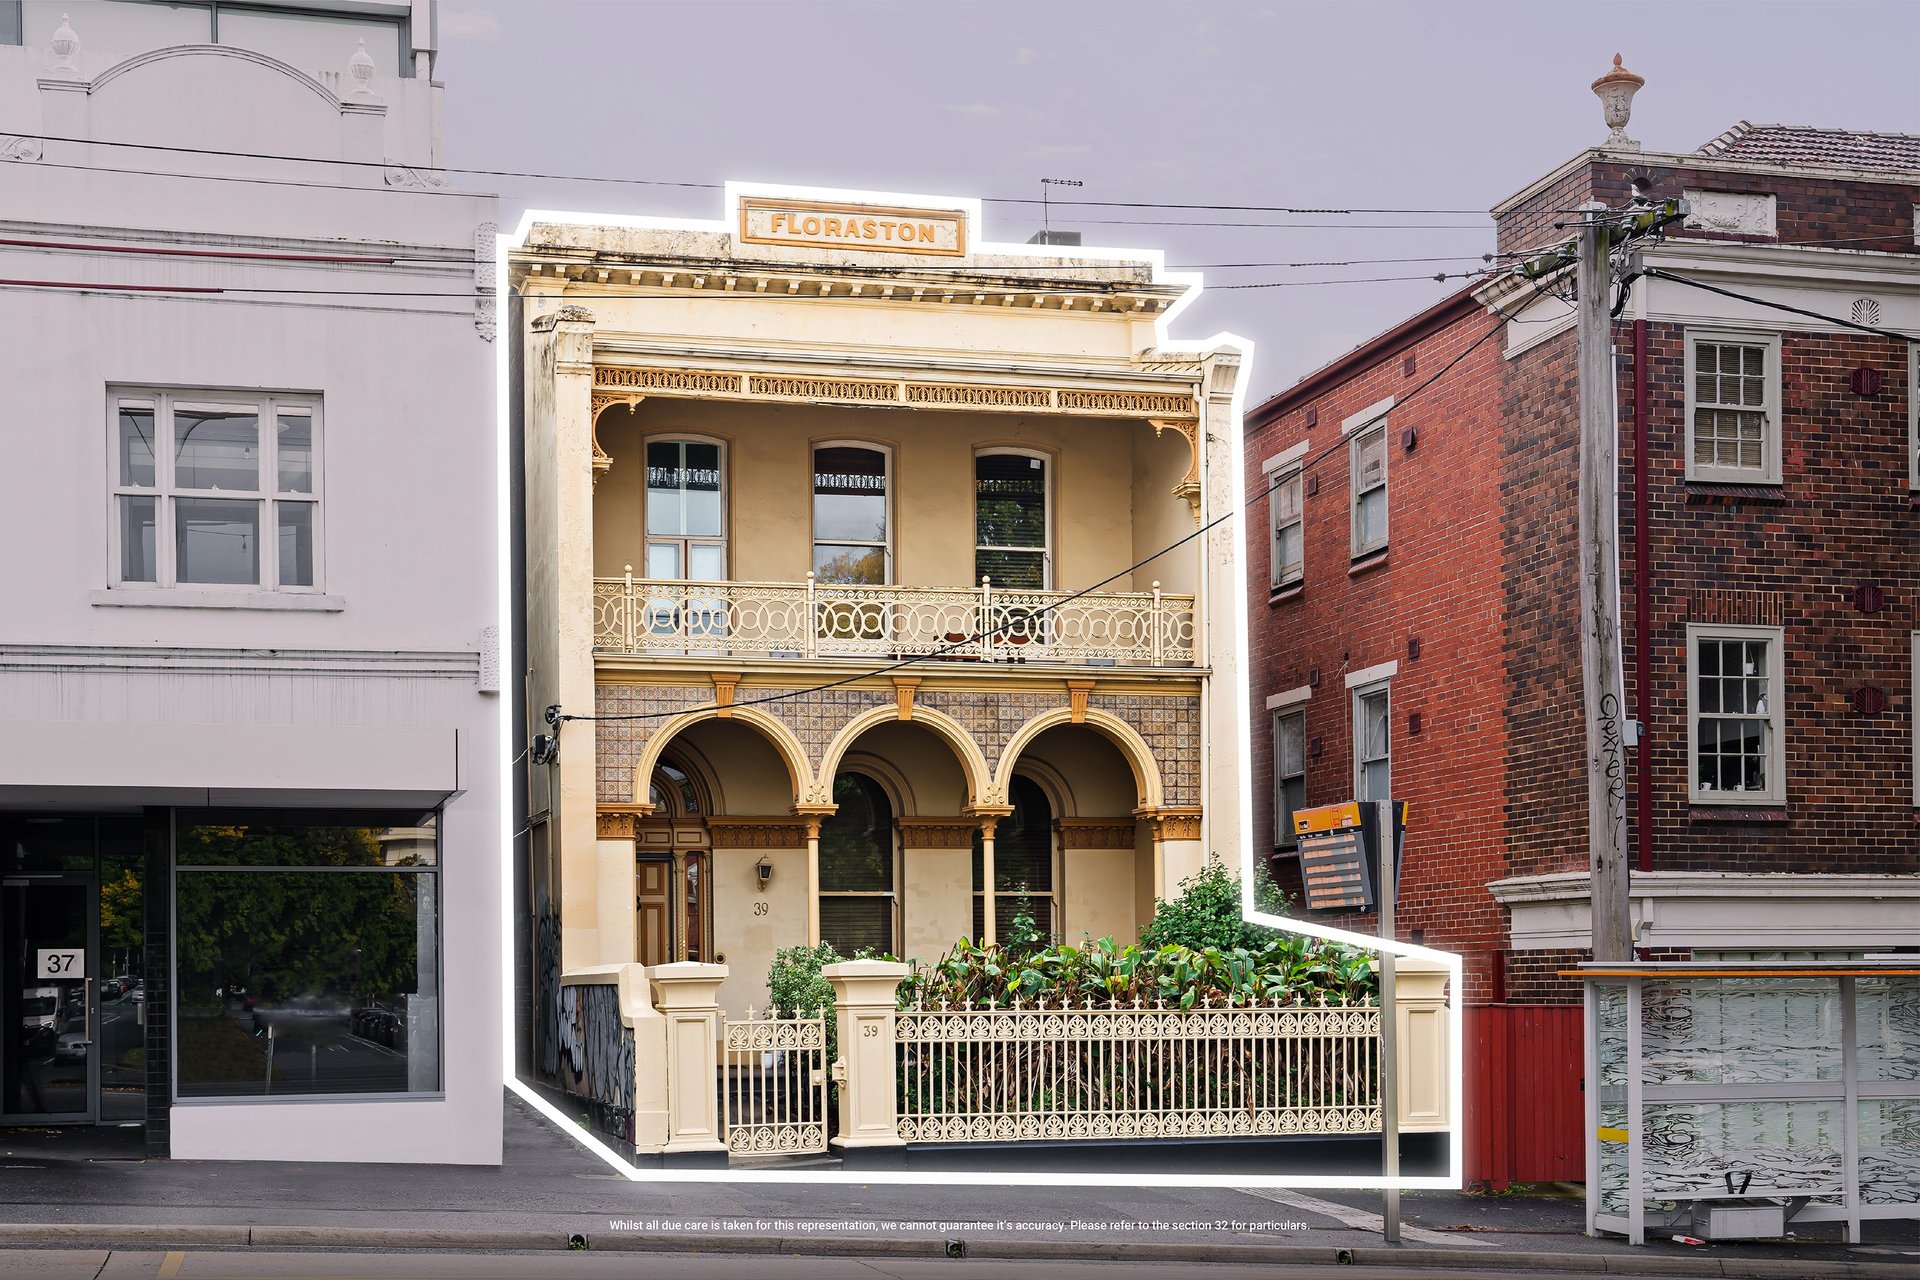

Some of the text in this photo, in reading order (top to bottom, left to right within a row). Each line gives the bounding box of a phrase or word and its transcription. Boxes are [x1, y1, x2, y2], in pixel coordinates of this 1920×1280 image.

[771, 213, 936, 243] FLORASTON
[753, 902, 769, 916] 39
[47, 954, 75, 974] 37
[863, 1025, 879, 1038] 39
